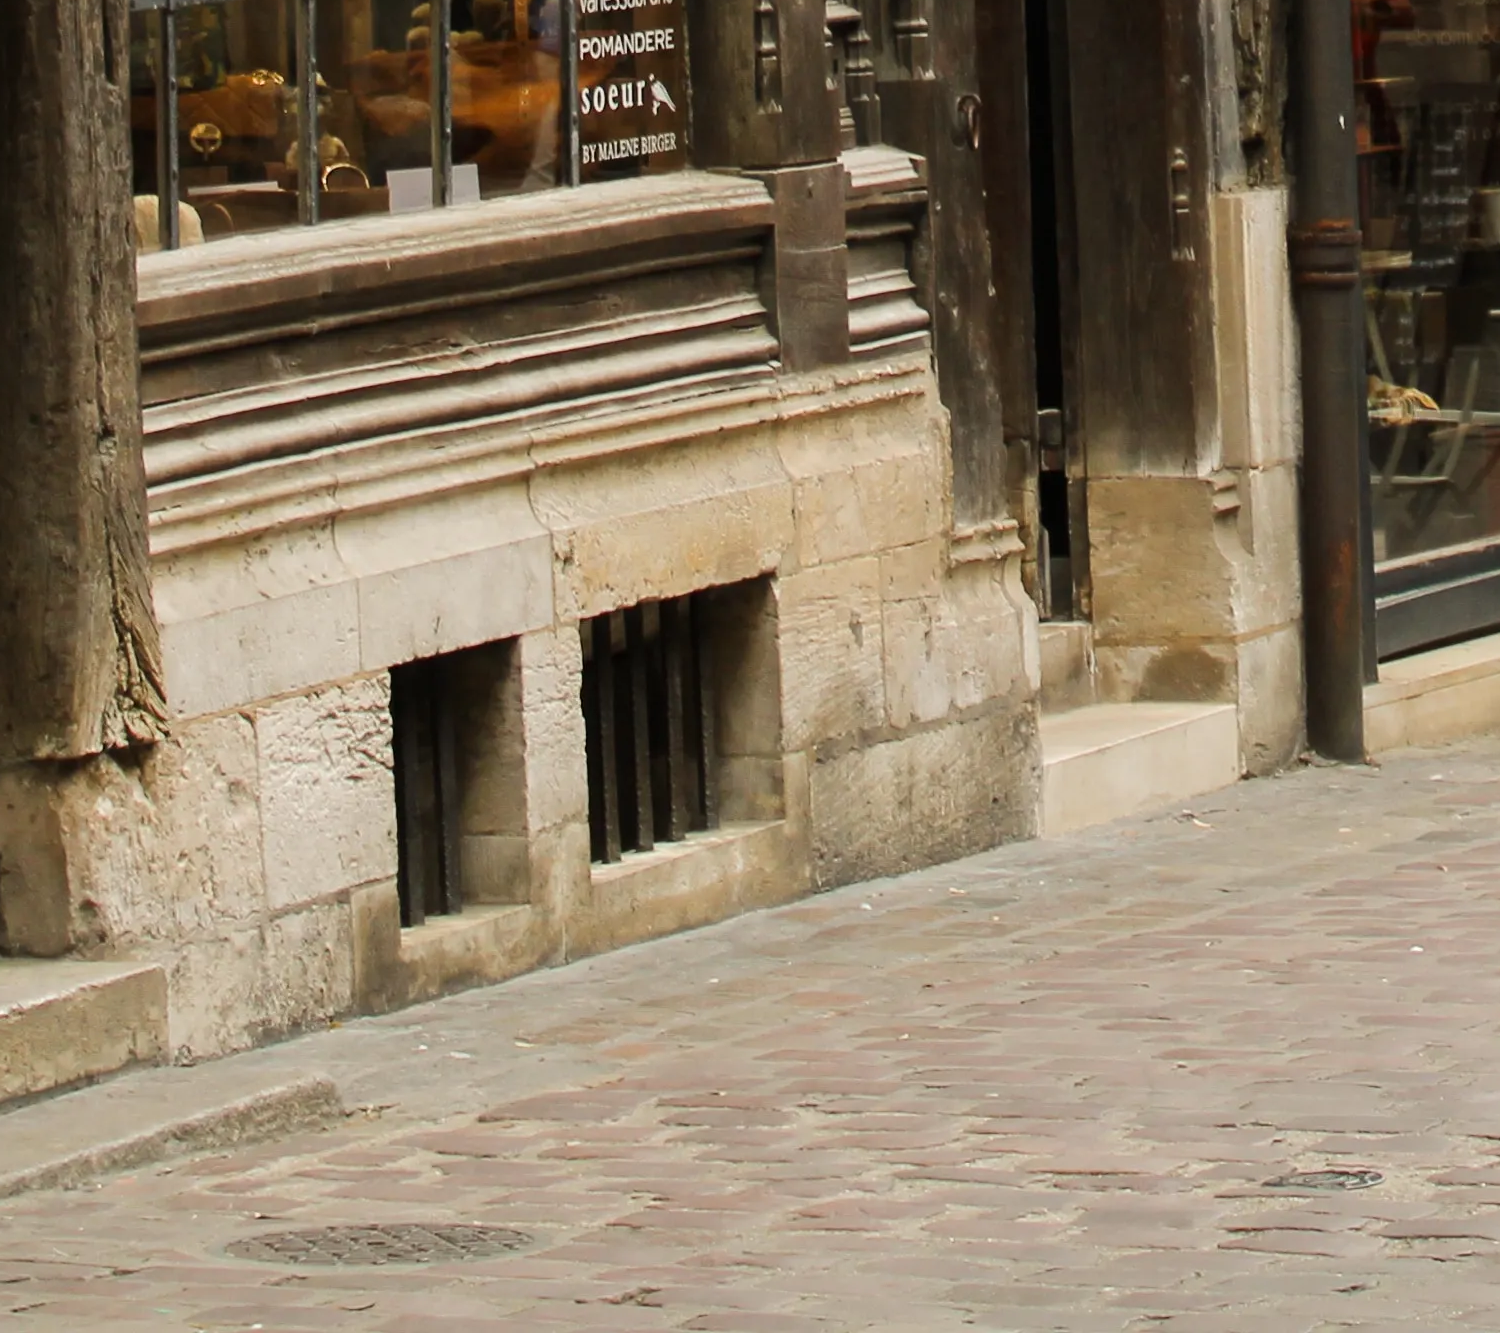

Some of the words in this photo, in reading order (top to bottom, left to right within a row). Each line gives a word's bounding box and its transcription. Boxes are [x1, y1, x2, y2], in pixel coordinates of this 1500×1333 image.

[579, 28, 675, 61] POMANDERE
[581, 77, 646, 115] soeur
[582, 142, 597, 165] BY
[598, 136, 640, 162] MALENE
[640, 132, 677, 158] BIRGER
